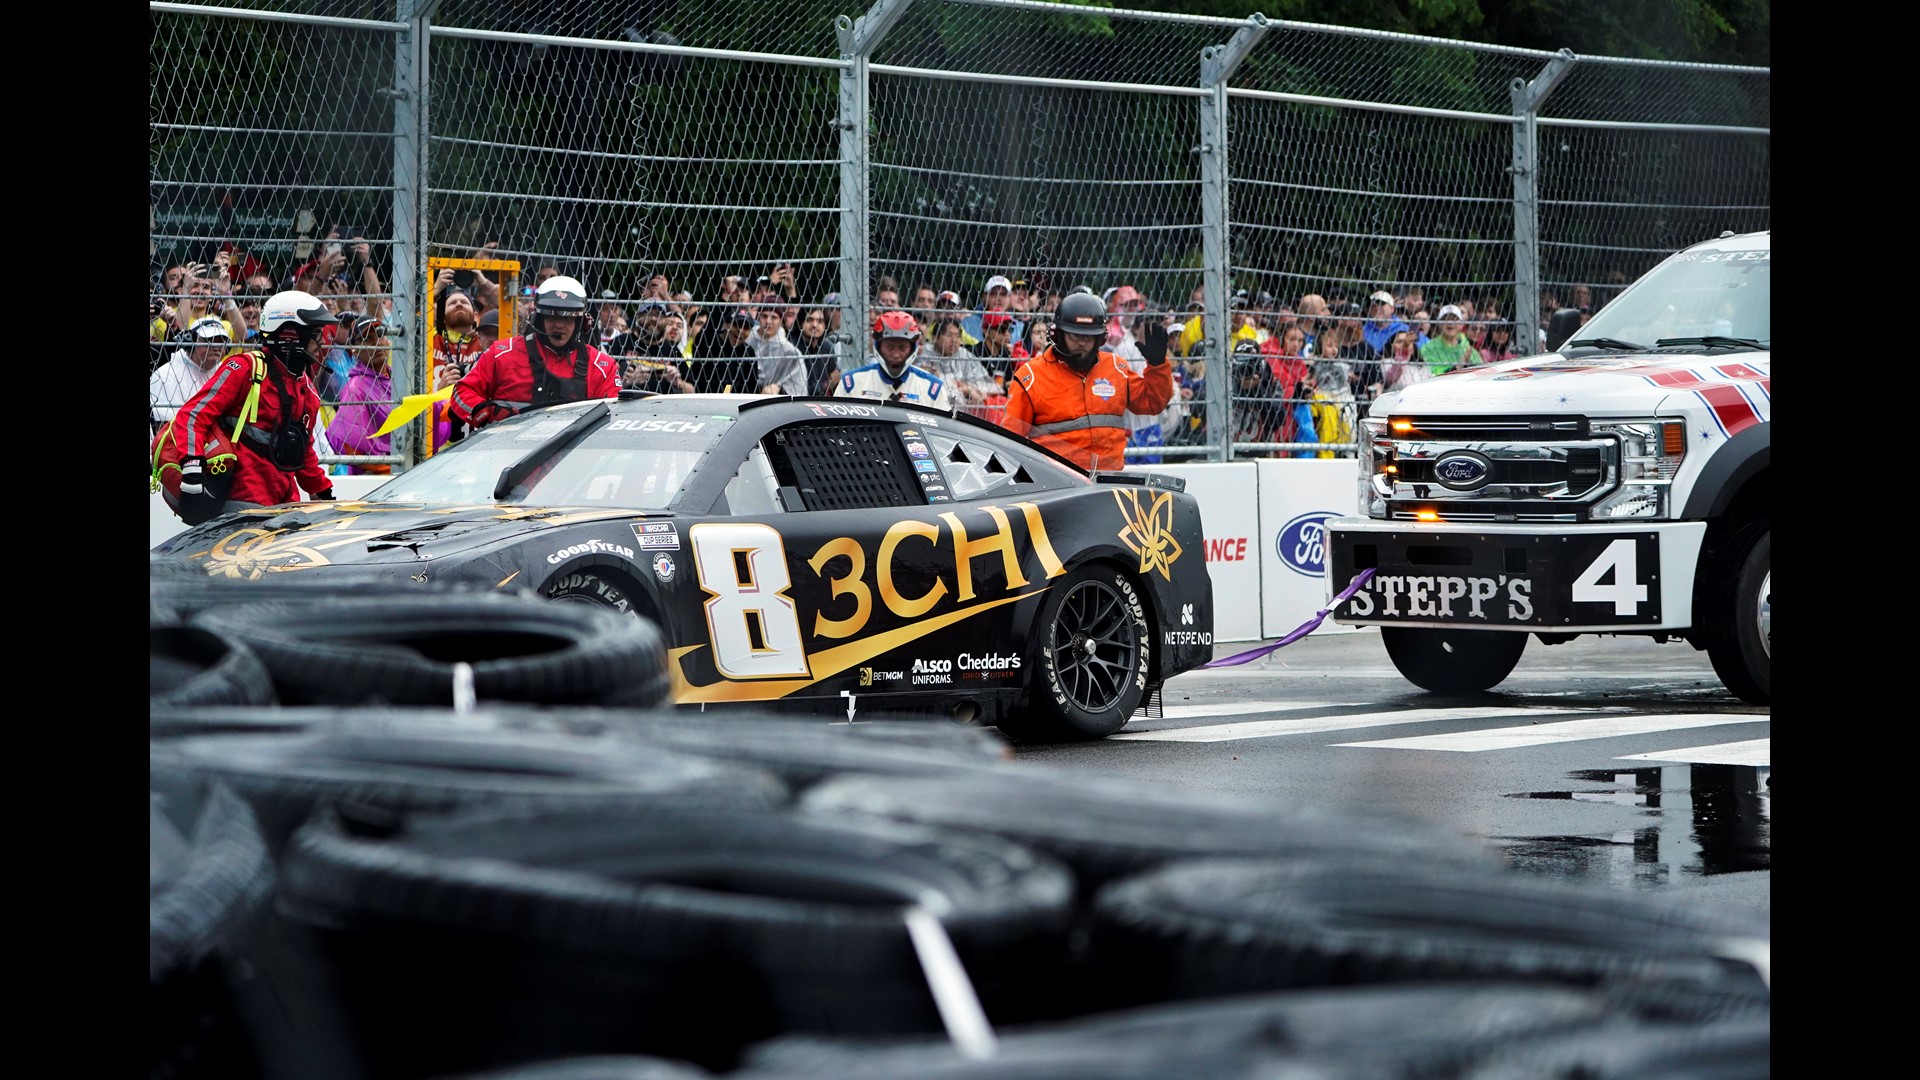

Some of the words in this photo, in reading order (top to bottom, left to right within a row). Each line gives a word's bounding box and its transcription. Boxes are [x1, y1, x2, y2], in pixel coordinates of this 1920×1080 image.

[822, 404, 879, 417] ROWDY
[606, 420, 706, 433] BUSCH
[1446, 462, 1474, 478] Ford
[645, 524, 670, 532] NASCAR
[644, 536, 655, 545] CUP
[654, 535, 674, 544] SERIES
[546, 539, 634, 564] GOODYEAR
[807, 502, 1067, 639] 3CHI
[1350, 574, 1534, 621] STEPP'S
[1572, 539, 1648, 615] 4
[690, 523, 813, 679] 8
[1115, 574, 1150, 691] GOODYEAR
[1164, 631, 1213, 646] NETSPEND
[957, 653, 1022, 670] Cheddar's
[872, 671, 904, 681] BETMGM
[1043, 646, 1067, 705] EAGLE
